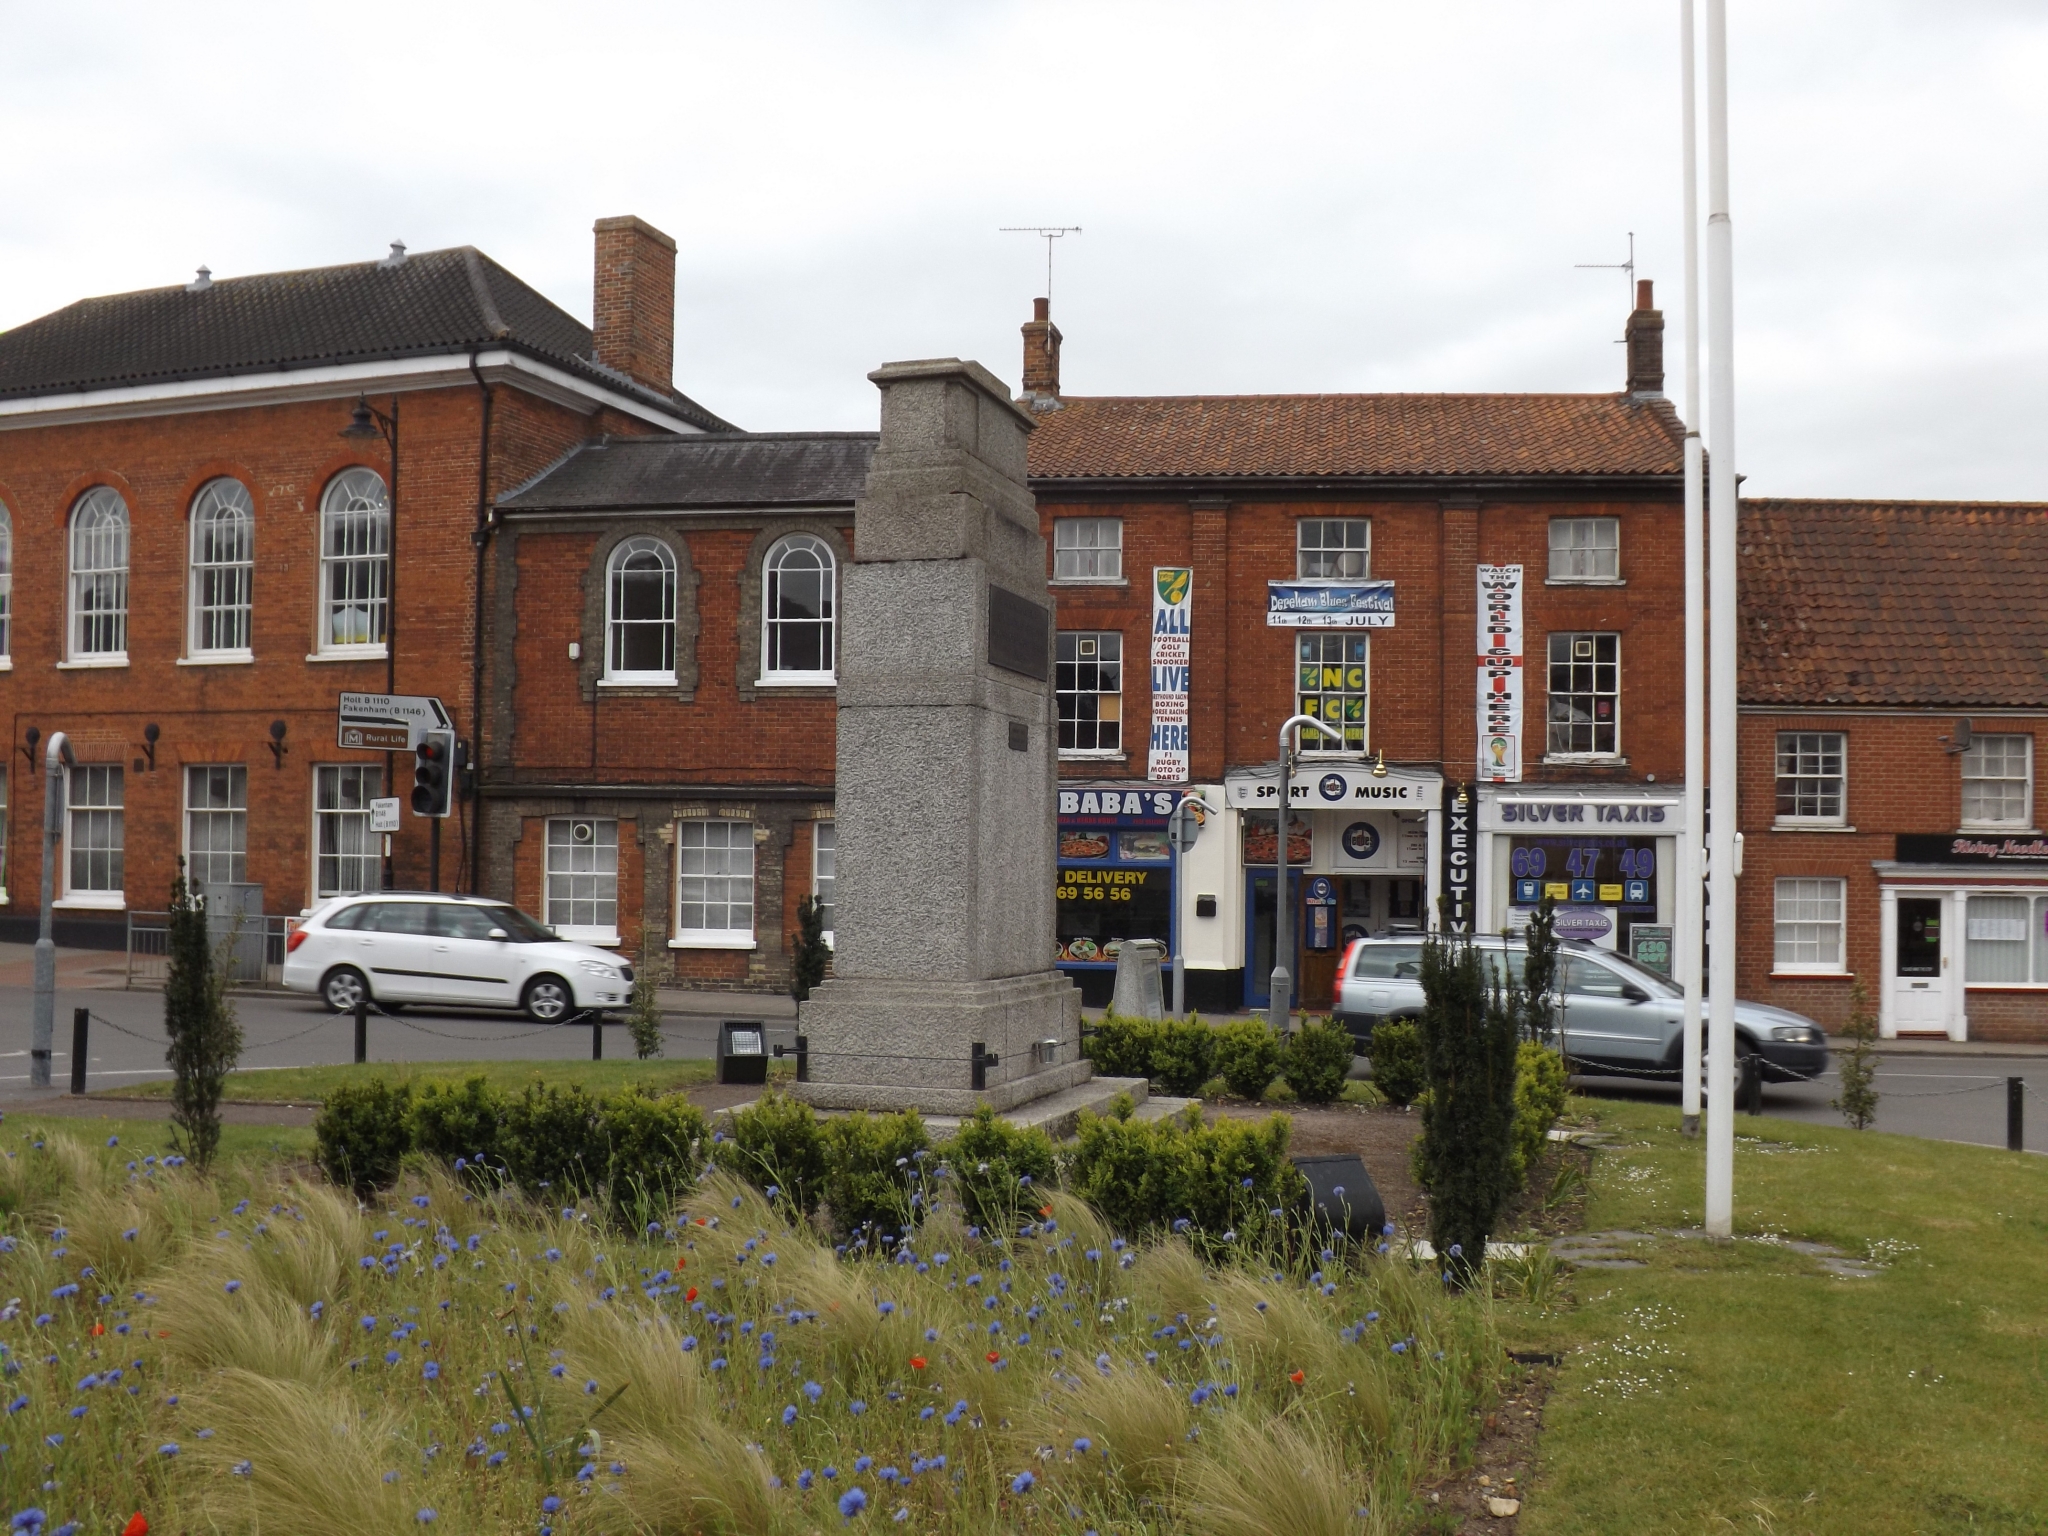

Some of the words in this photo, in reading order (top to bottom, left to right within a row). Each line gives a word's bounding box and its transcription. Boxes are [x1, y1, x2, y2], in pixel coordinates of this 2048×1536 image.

[1271, 591, 1317, 611] Dereham
[1320, 591, 1347, 607] Blues
[1350, 594, 1394, 611] Festival
[1482, 582, 1517, 634] WORLD
[1154, 609, 1189, 634] ALL
[1272, 616, 1287, 624] 11th
[1297, 616, 1312, 624] 12th
[1345, 616, 1389, 625] JULY
[1486, 648, 1513, 677] CUP
[1153, 666, 1189, 691] LIVE
[343, 705, 387, 713] Fakenham
[1487, 692, 1512, 733] HERE
[366, 734, 388, 742] Rural
[391, 735, 406, 743] Life
[1151, 725, 1187, 750] HERE
[1355, 787, 1407, 798] MUSIC
[1059, 792, 1172, 814] BABA'S
[1501, 804, 1583, 822] SILVER
[1595, 804, 1665, 822] TAXIS
[1951, 839, 1998, 858] Rising
[1449, 799, 1468, 933] EXECUTIV
[1511, 847, 1546, 877] 69
[1566, 848, 1600, 878] 47
[1619, 848, 1654, 878] 49
[1065, 871, 1147, 884] DELIVERY
[1057, 886, 1077, 899] 69
[1083, 888, 1104, 900] 56
[1110, 888, 1131, 900] 56
[1556, 919, 1583, 927] SILVER
[1585, 919, 1608, 927] TAXIS
[1637, 941, 1667, 953] £30
